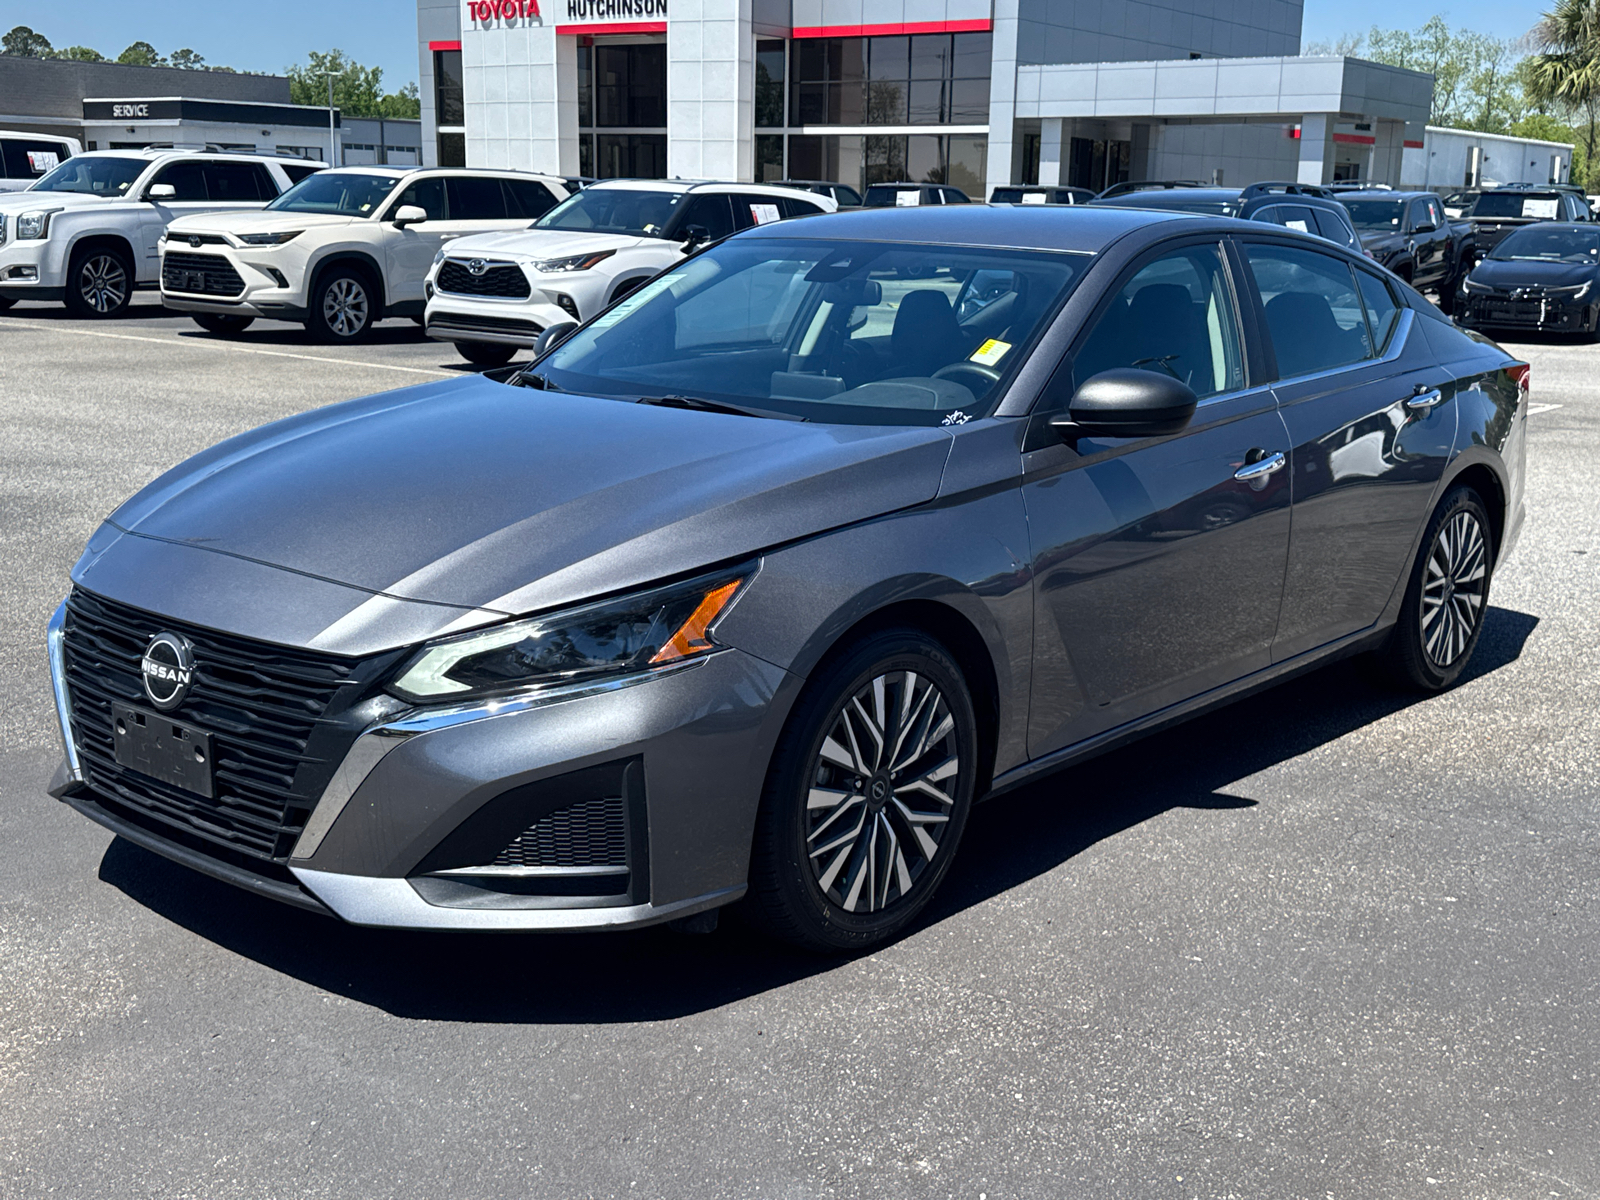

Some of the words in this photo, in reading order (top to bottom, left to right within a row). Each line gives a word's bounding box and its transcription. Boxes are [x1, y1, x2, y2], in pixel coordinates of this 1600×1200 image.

[467, 0, 540, 21] TOYOTA
[567, 0, 668, 17] HUTCHINSON
[113, 104, 149, 117] SERVICE
[141, 658, 190, 683] NISSAN
